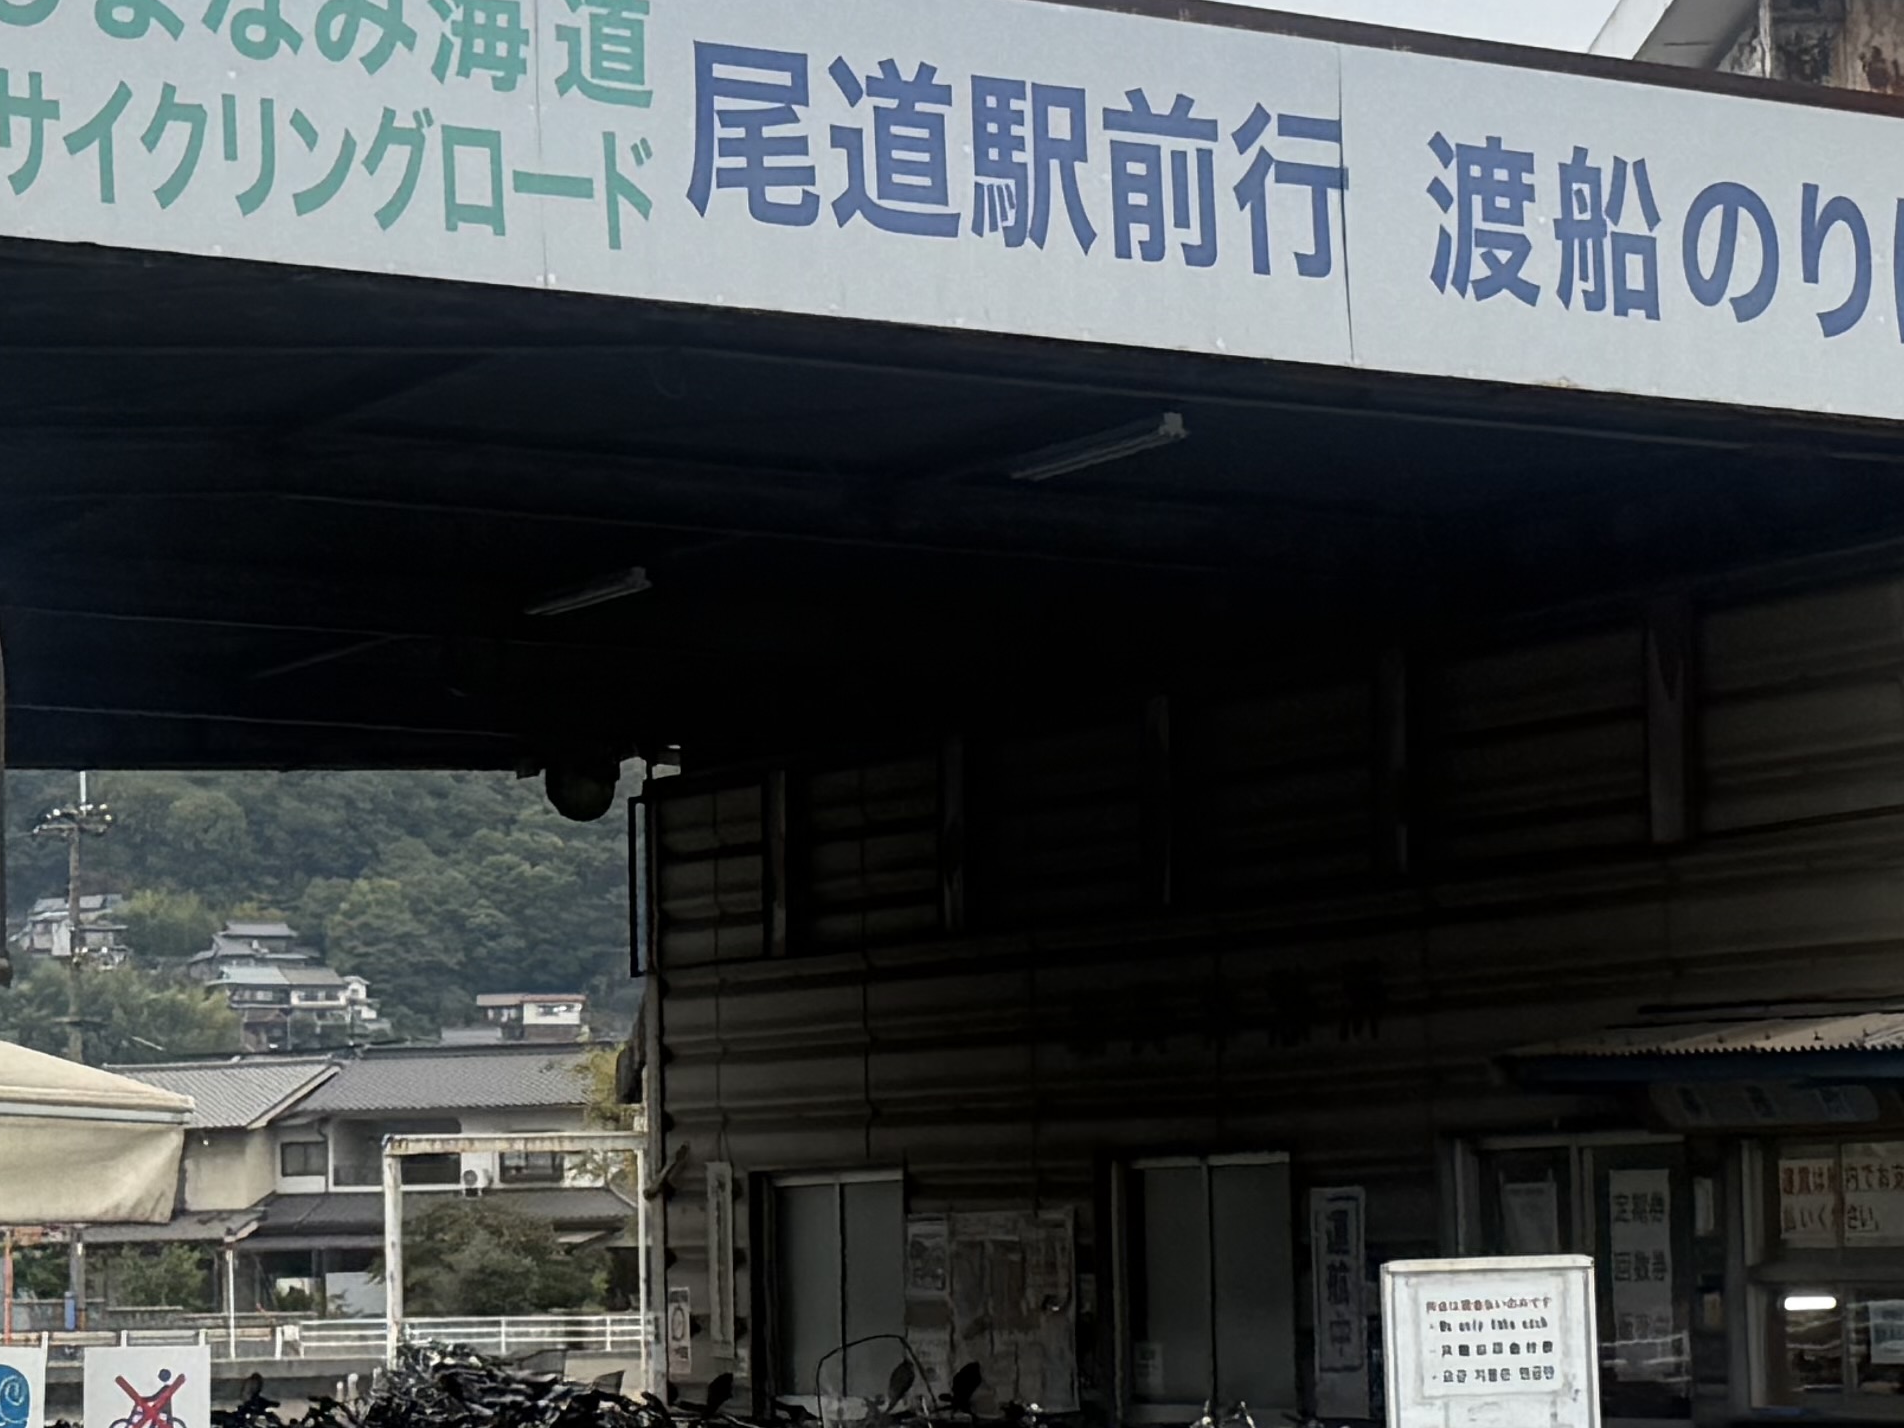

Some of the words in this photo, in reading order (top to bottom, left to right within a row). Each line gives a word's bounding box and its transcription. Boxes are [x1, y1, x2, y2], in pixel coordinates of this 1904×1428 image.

[684, 37, 1347, 280] 尾道駅前行
